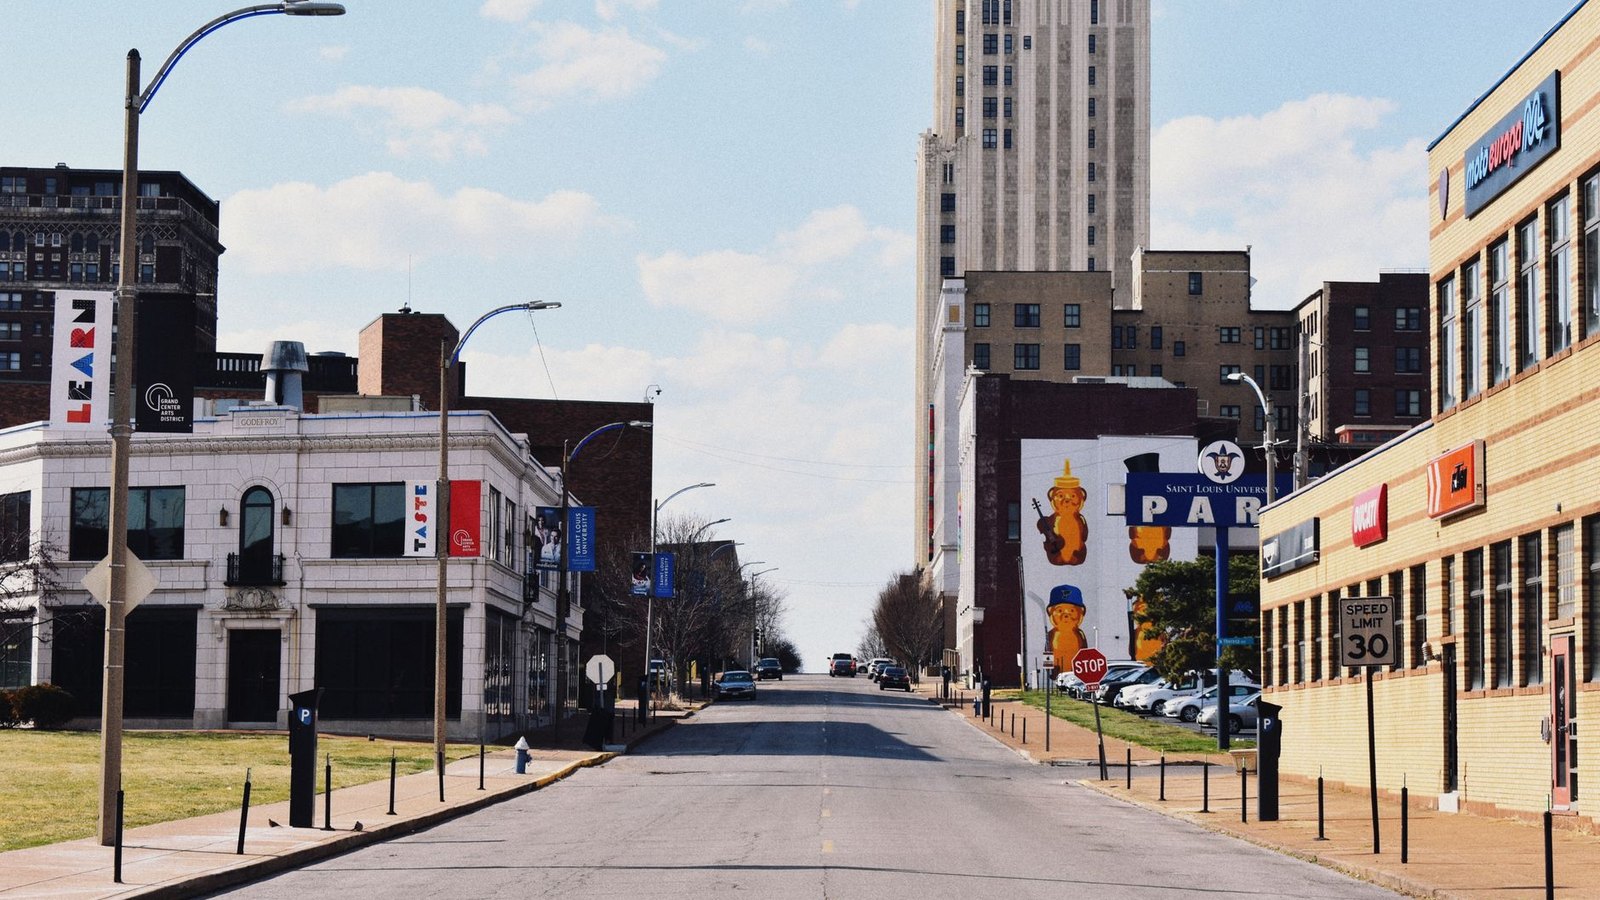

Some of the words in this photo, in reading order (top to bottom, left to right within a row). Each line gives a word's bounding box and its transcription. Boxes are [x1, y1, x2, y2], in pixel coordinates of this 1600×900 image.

[67, 300, 96, 423] LEARN
[240, 418, 279, 426] GODEFROY
[414, 485, 427, 552] TASTE
[1346, 604, 1388, 615] SPEED
[1352, 618, 1383, 628] LIMIT
[1348, 634, 1388, 659] 30
[1075, 658, 1105, 674] STOP
[302, 709, 310, 722] P
[1264, 718, 1270, 730] P
